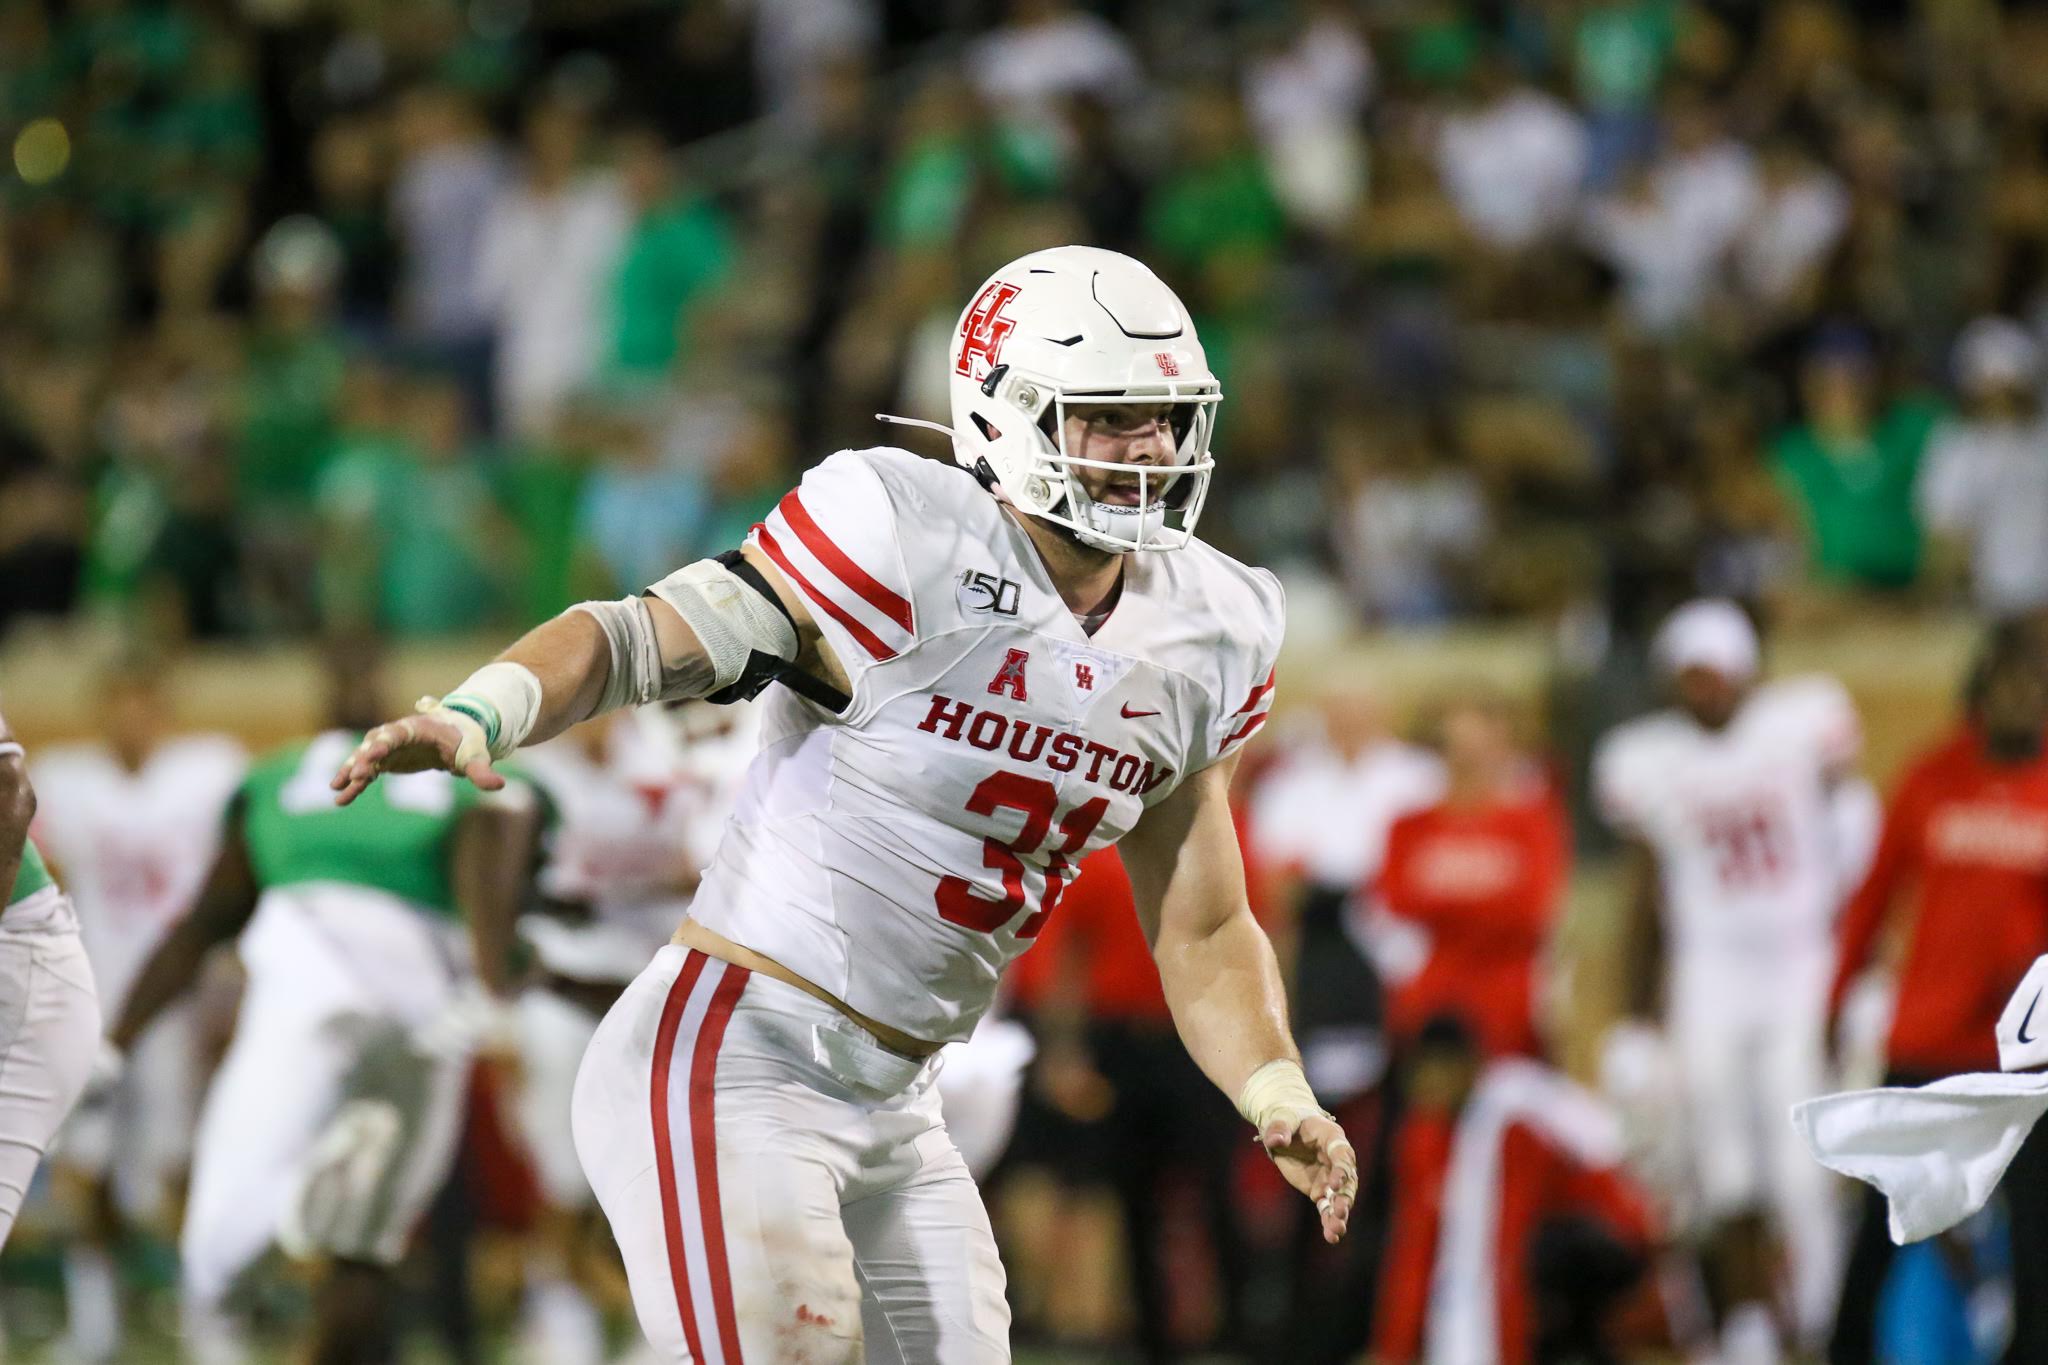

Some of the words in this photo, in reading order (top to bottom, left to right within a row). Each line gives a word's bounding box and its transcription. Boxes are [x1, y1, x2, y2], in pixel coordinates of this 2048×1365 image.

[961, 568, 1022, 616] 150
[987, 647, 1030, 702] A
[917, 694, 1174, 796] HOUSTON
[934, 769, 1110, 939] 31
